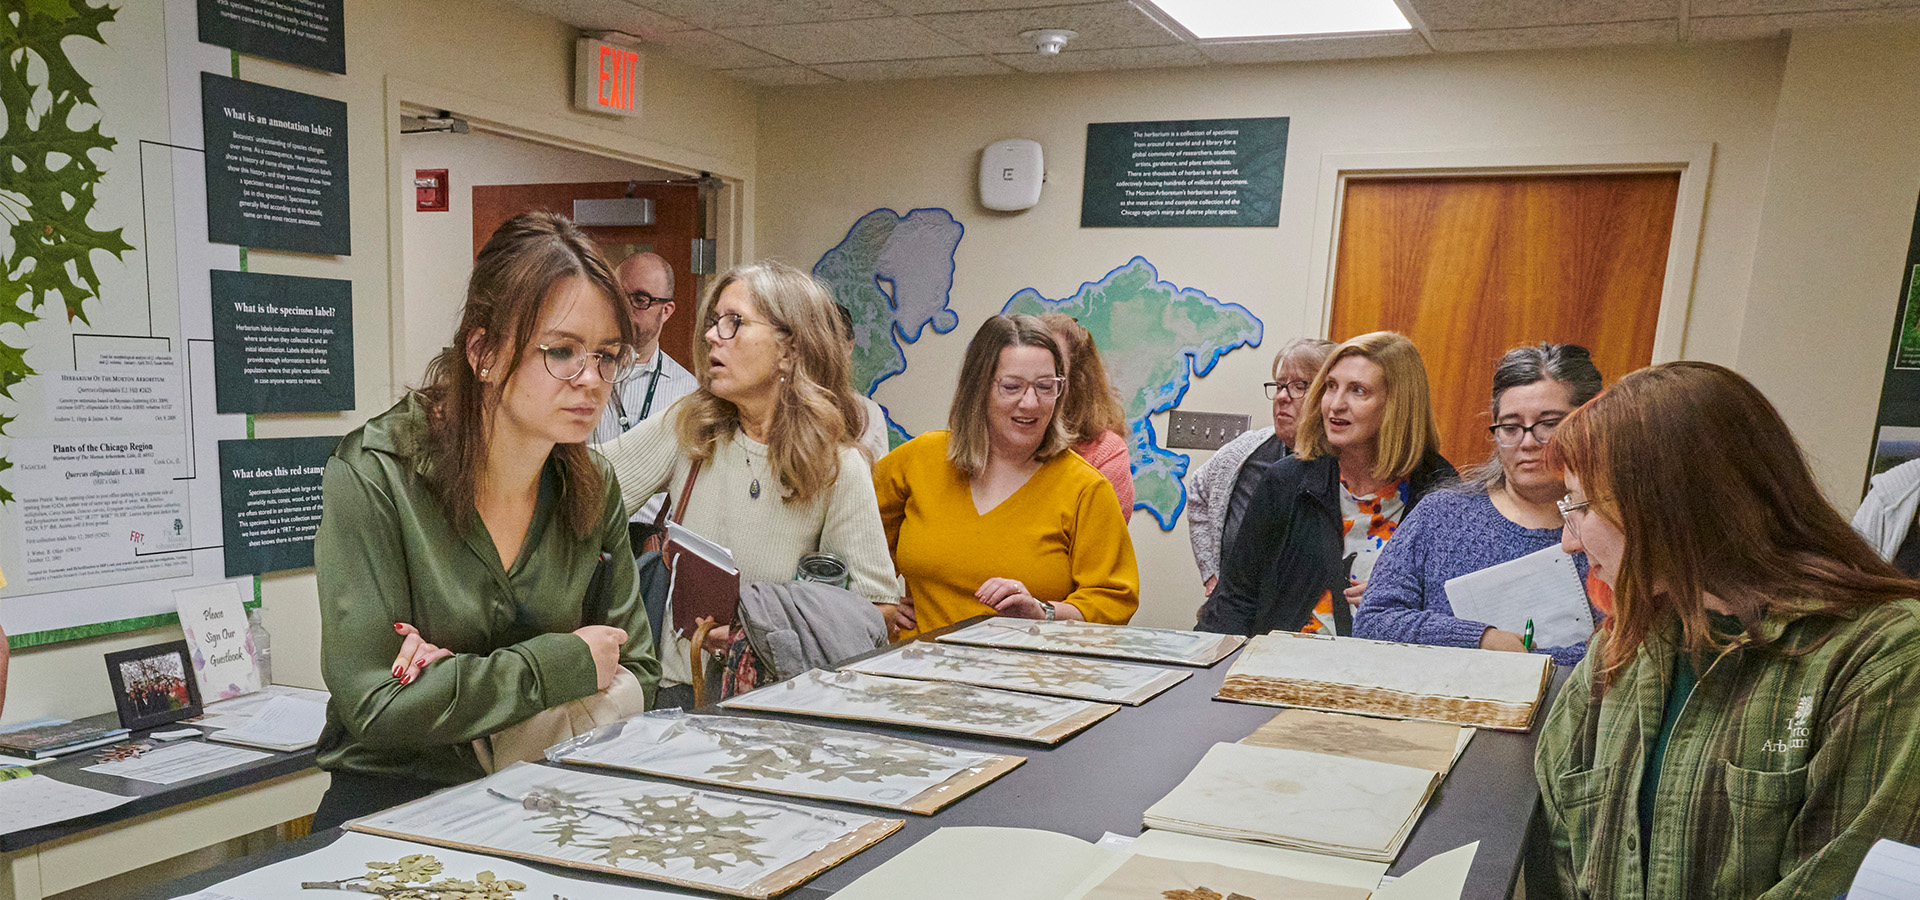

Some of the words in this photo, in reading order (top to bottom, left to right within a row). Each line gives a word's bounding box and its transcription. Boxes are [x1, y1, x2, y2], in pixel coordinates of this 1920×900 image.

[598, 45, 638, 111] EXIT
[224, 107, 246, 120] What
[248, 112, 255, 122] is
[257, 115, 266, 124] an
[269, 119, 309, 132] annotation
[312, 124, 332, 137] label?
[234, 303, 255, 313] What
[258, 305, 264, 313] is
[267, 304, 278, 314] the
[280, 306, 313, 318] specimen
[315, 306, 335, 316] label?
[53, 444, 76, 453] Plants
[78, 444, 85, 452] of
[87, 444, 98, 452] the
[100, 442, 128, 453] Chicago
[130, 442, 153, 452] Region
[233, 468, 254, 478] What
[256, 468, 273, 477] does
[274, 467, 288, 476] this
[290, 466, 302, 476] red
[304, 466, 324, 477] stamp
[249, 489, 271, 497] Specimens
[130, 531, 144, 545] FRT.
[203, 607, 224, 620] Please
[205, 632, 220, 648] Sign
[222, 628, 235, 640] Our
[210, 647, 244, 666] Guestbook
